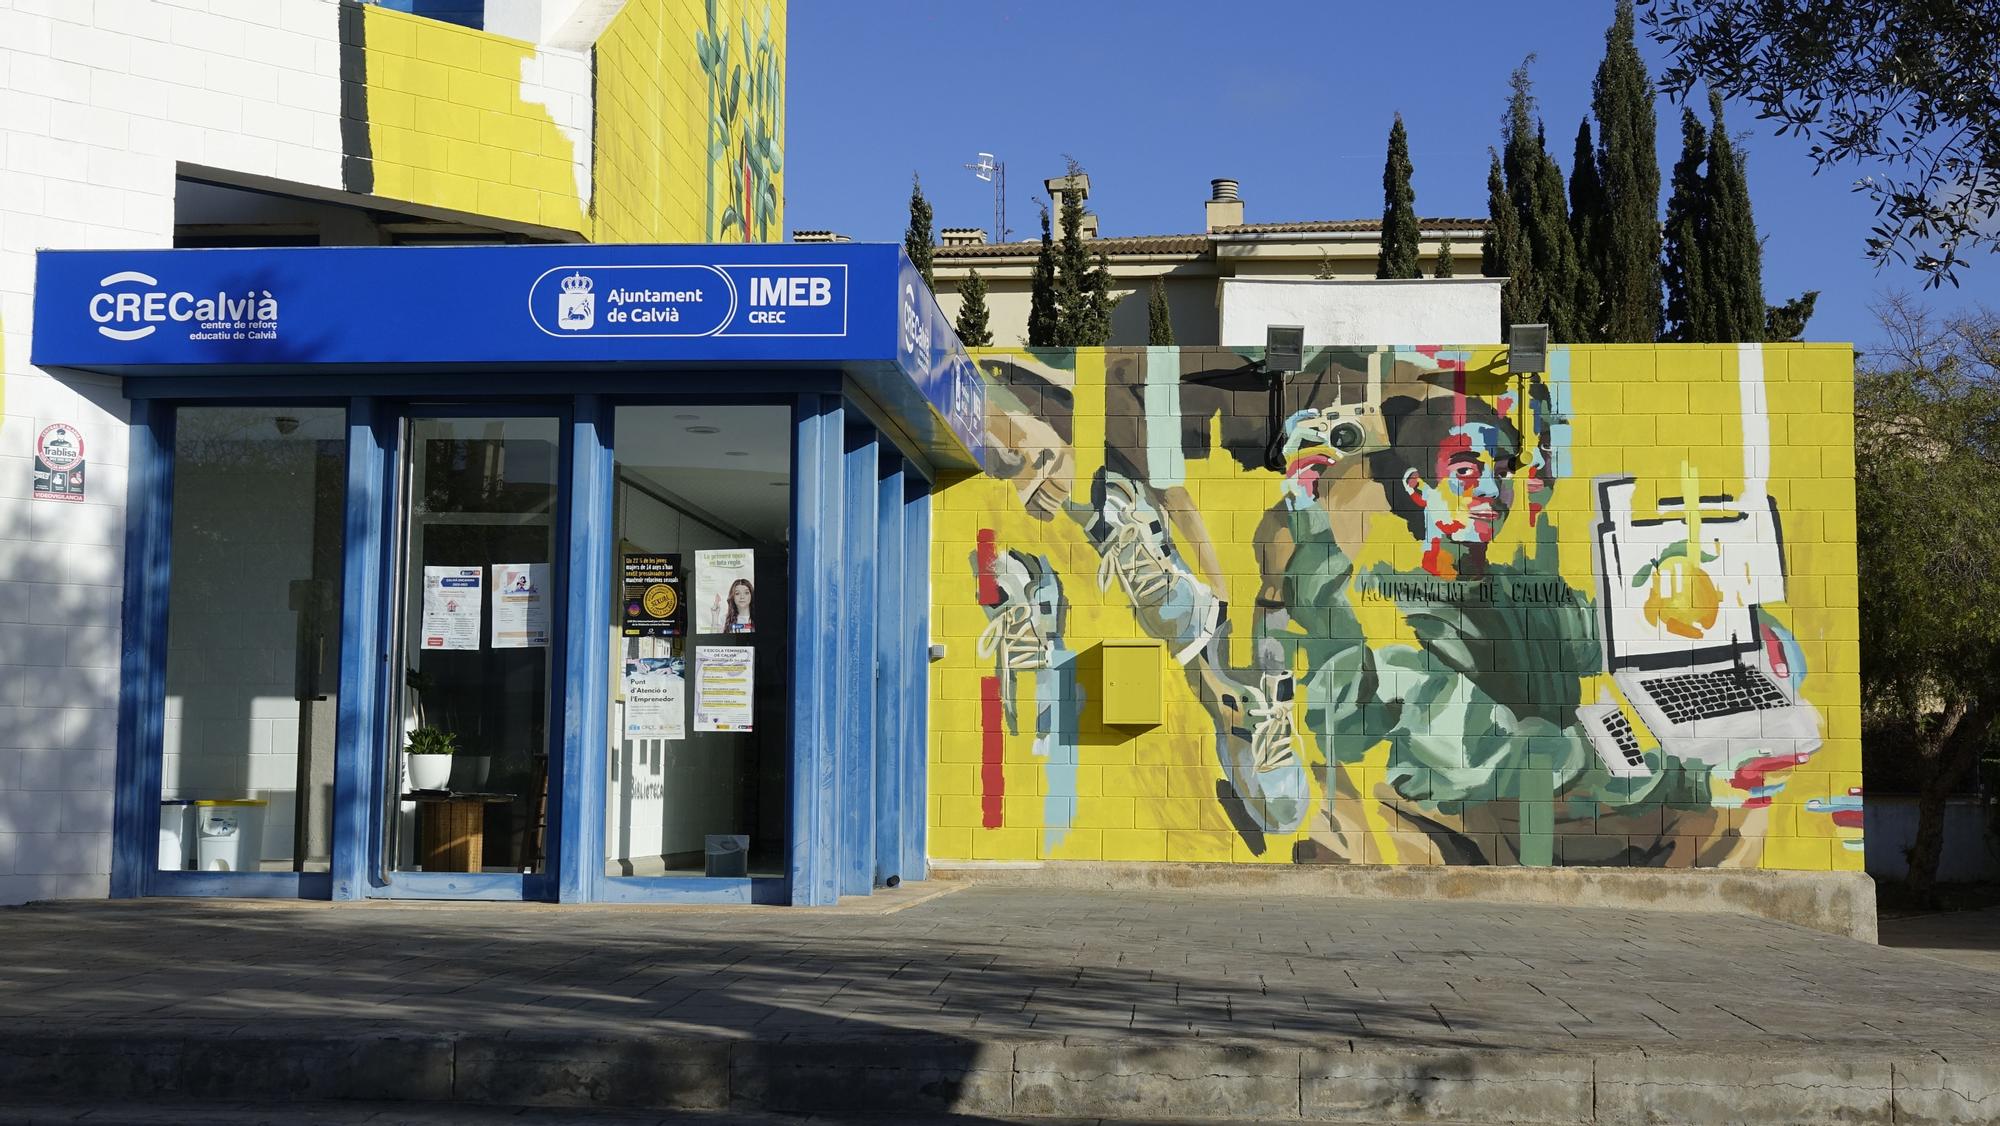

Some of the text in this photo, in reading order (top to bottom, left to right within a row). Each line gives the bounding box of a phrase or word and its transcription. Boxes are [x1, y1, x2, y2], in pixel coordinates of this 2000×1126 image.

[607, 288, 703, 306] Ajuntament
[750, 277, 832, 307] IMEB
[607, 307, 679, 323] de Calvià
[748, 311, 786, 324] CREC
[201, 320, 277, 331] centre de reforç
[189, 330, 277, 341] educatiu de Calvià
[43, 446, 77, 458] Trablisa
[35, 492, 83, 502] VIDEOVIGILANCIA
[1362, 582, 1465, 602] AJUNTAMENT
[1480, 583, 1500, 602] DE
